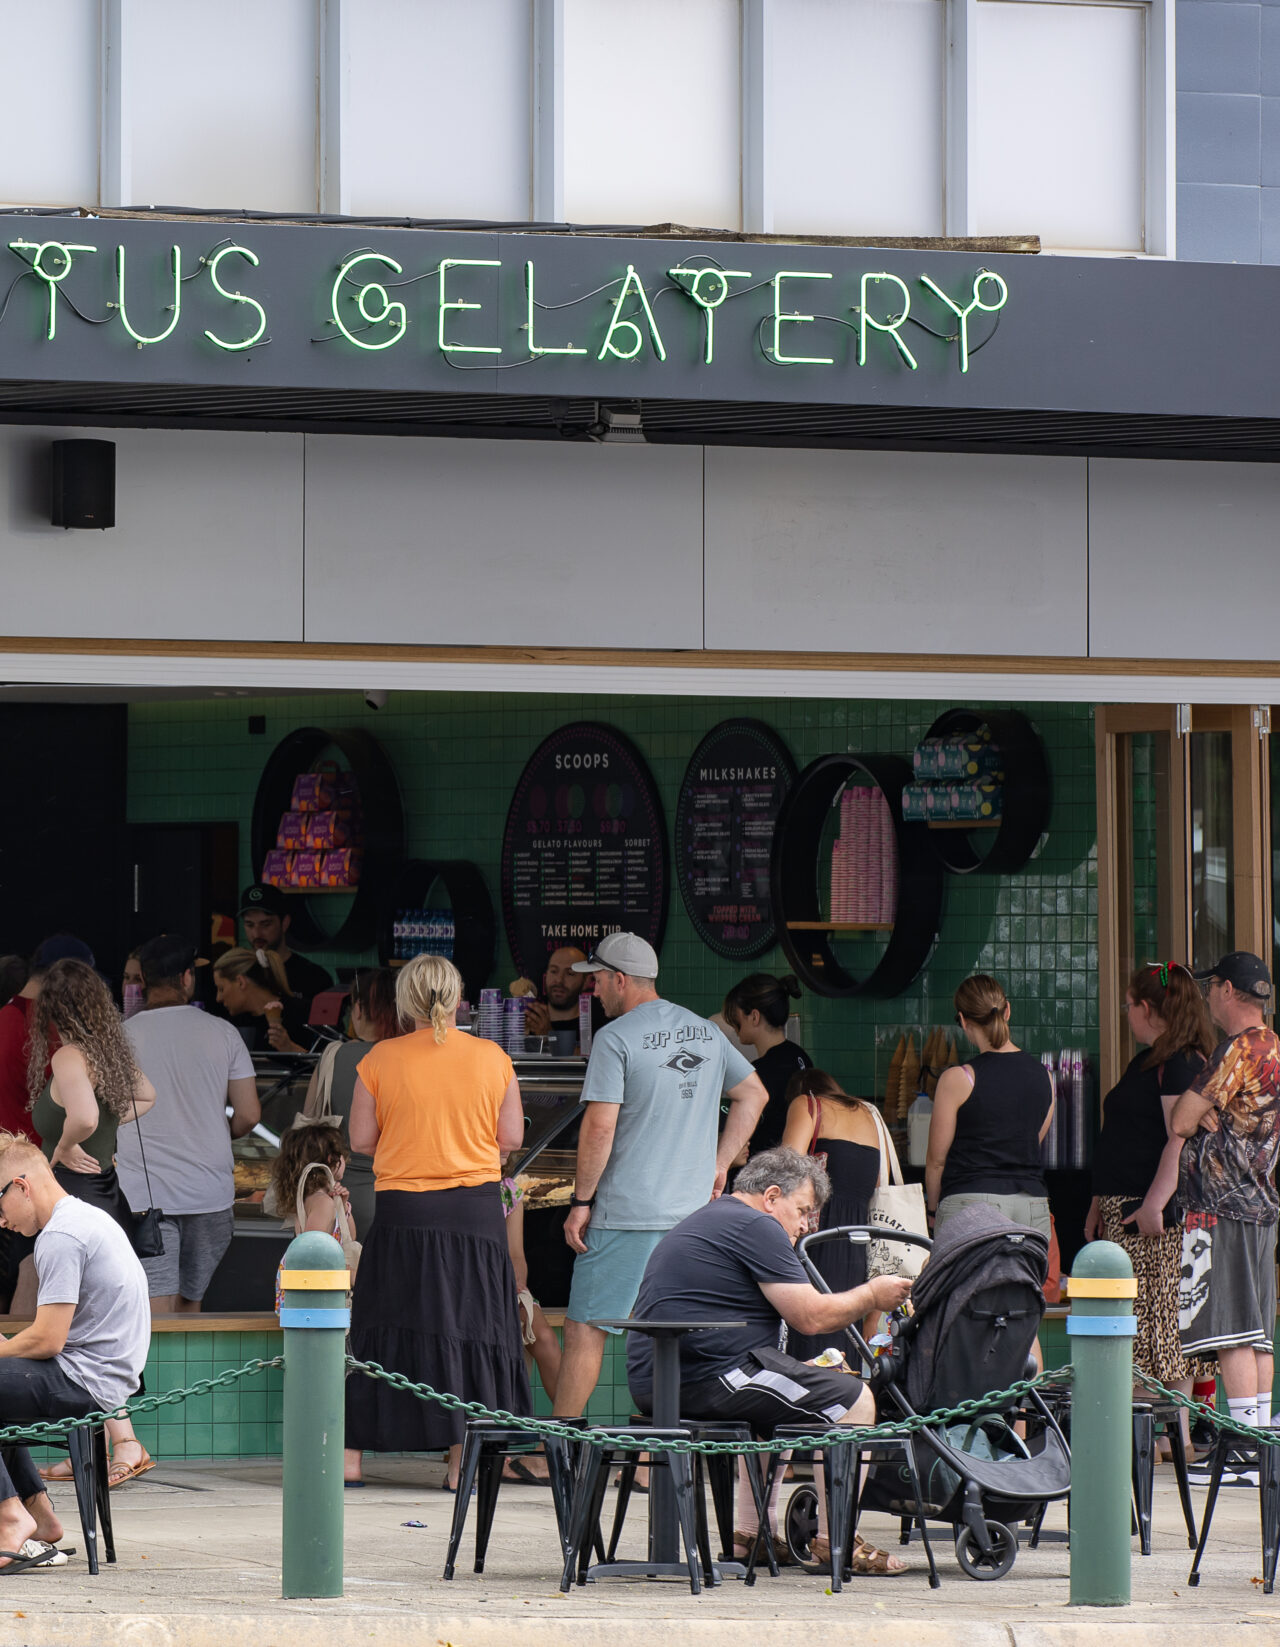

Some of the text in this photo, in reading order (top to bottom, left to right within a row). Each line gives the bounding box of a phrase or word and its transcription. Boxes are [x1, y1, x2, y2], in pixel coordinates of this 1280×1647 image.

[331, 252, 1009, 373] GELATERY
[555, 753, 609, 769] SCOOPS
[700, 767, 777, 781] MILKSHAKES
[532, 839, 602, 849] GELATO FLAVOURS
[624, 838, 650, 848] SORBET
[541, 924, 567, 937] TAKE
[571, 924, 599, 937] HOME
[643, 1031, 671, 1050] RIP
